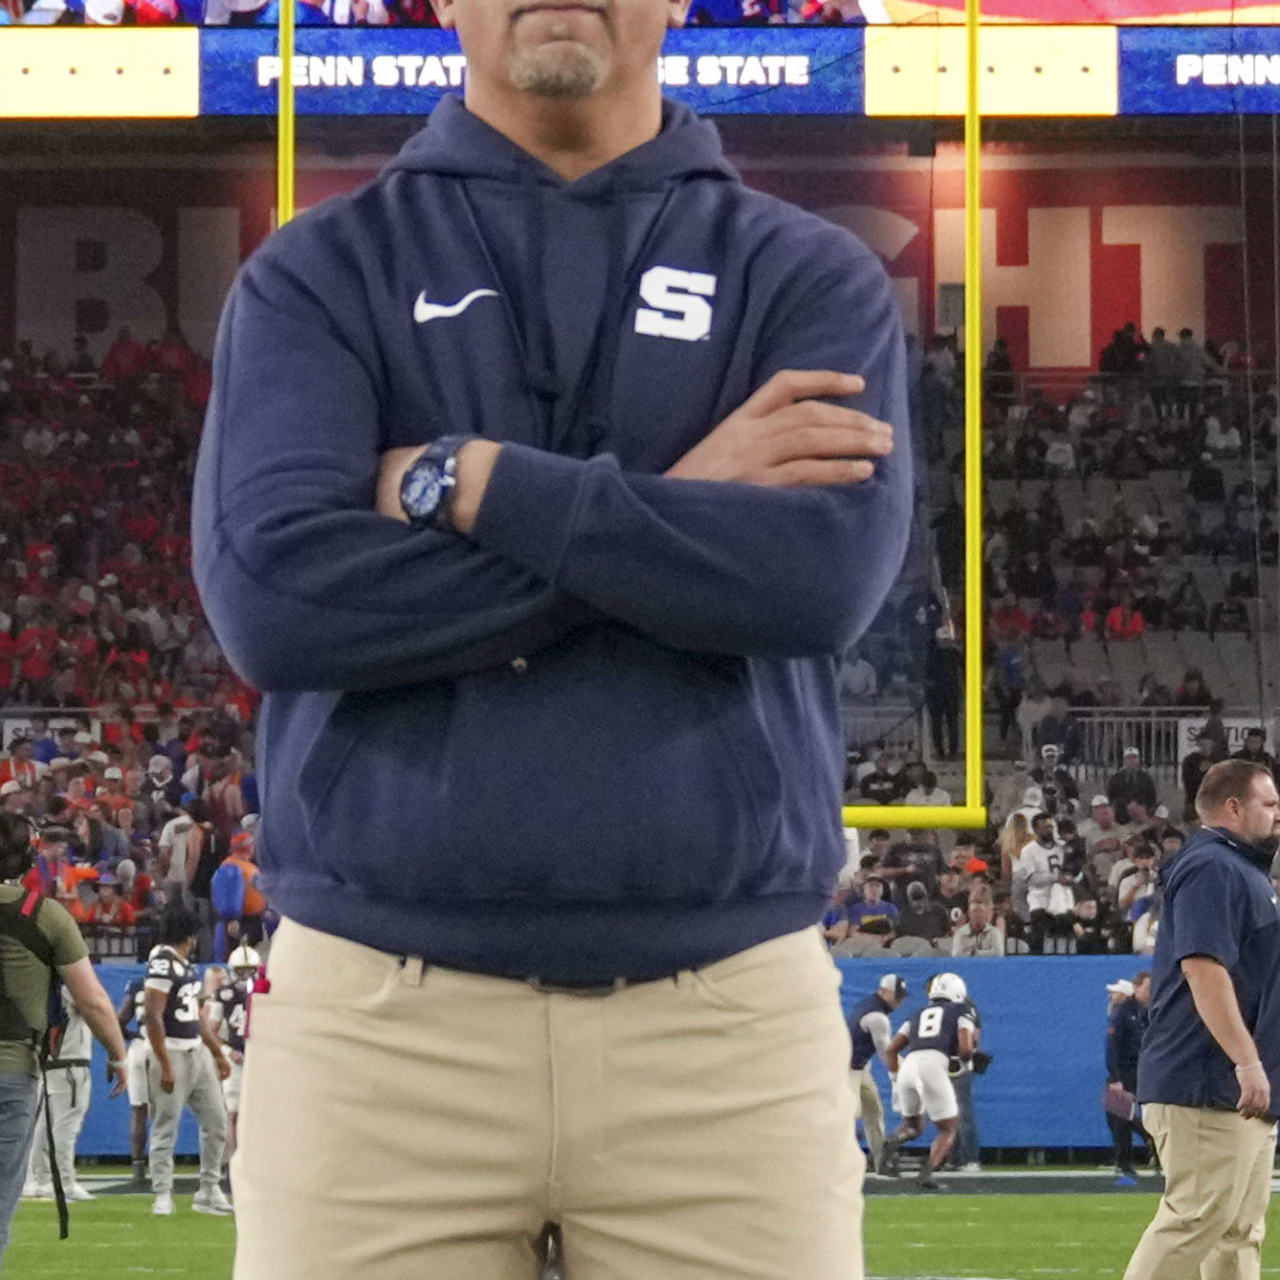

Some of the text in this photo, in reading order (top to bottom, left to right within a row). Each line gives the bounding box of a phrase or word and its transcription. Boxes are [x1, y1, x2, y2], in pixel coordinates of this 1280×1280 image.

[257, 55, 468, 87] PENN STAT
[696, 55, 811, 86] STATE
[634, 265, 717, 342] S
[918, 1006, 944, 1038] 8
